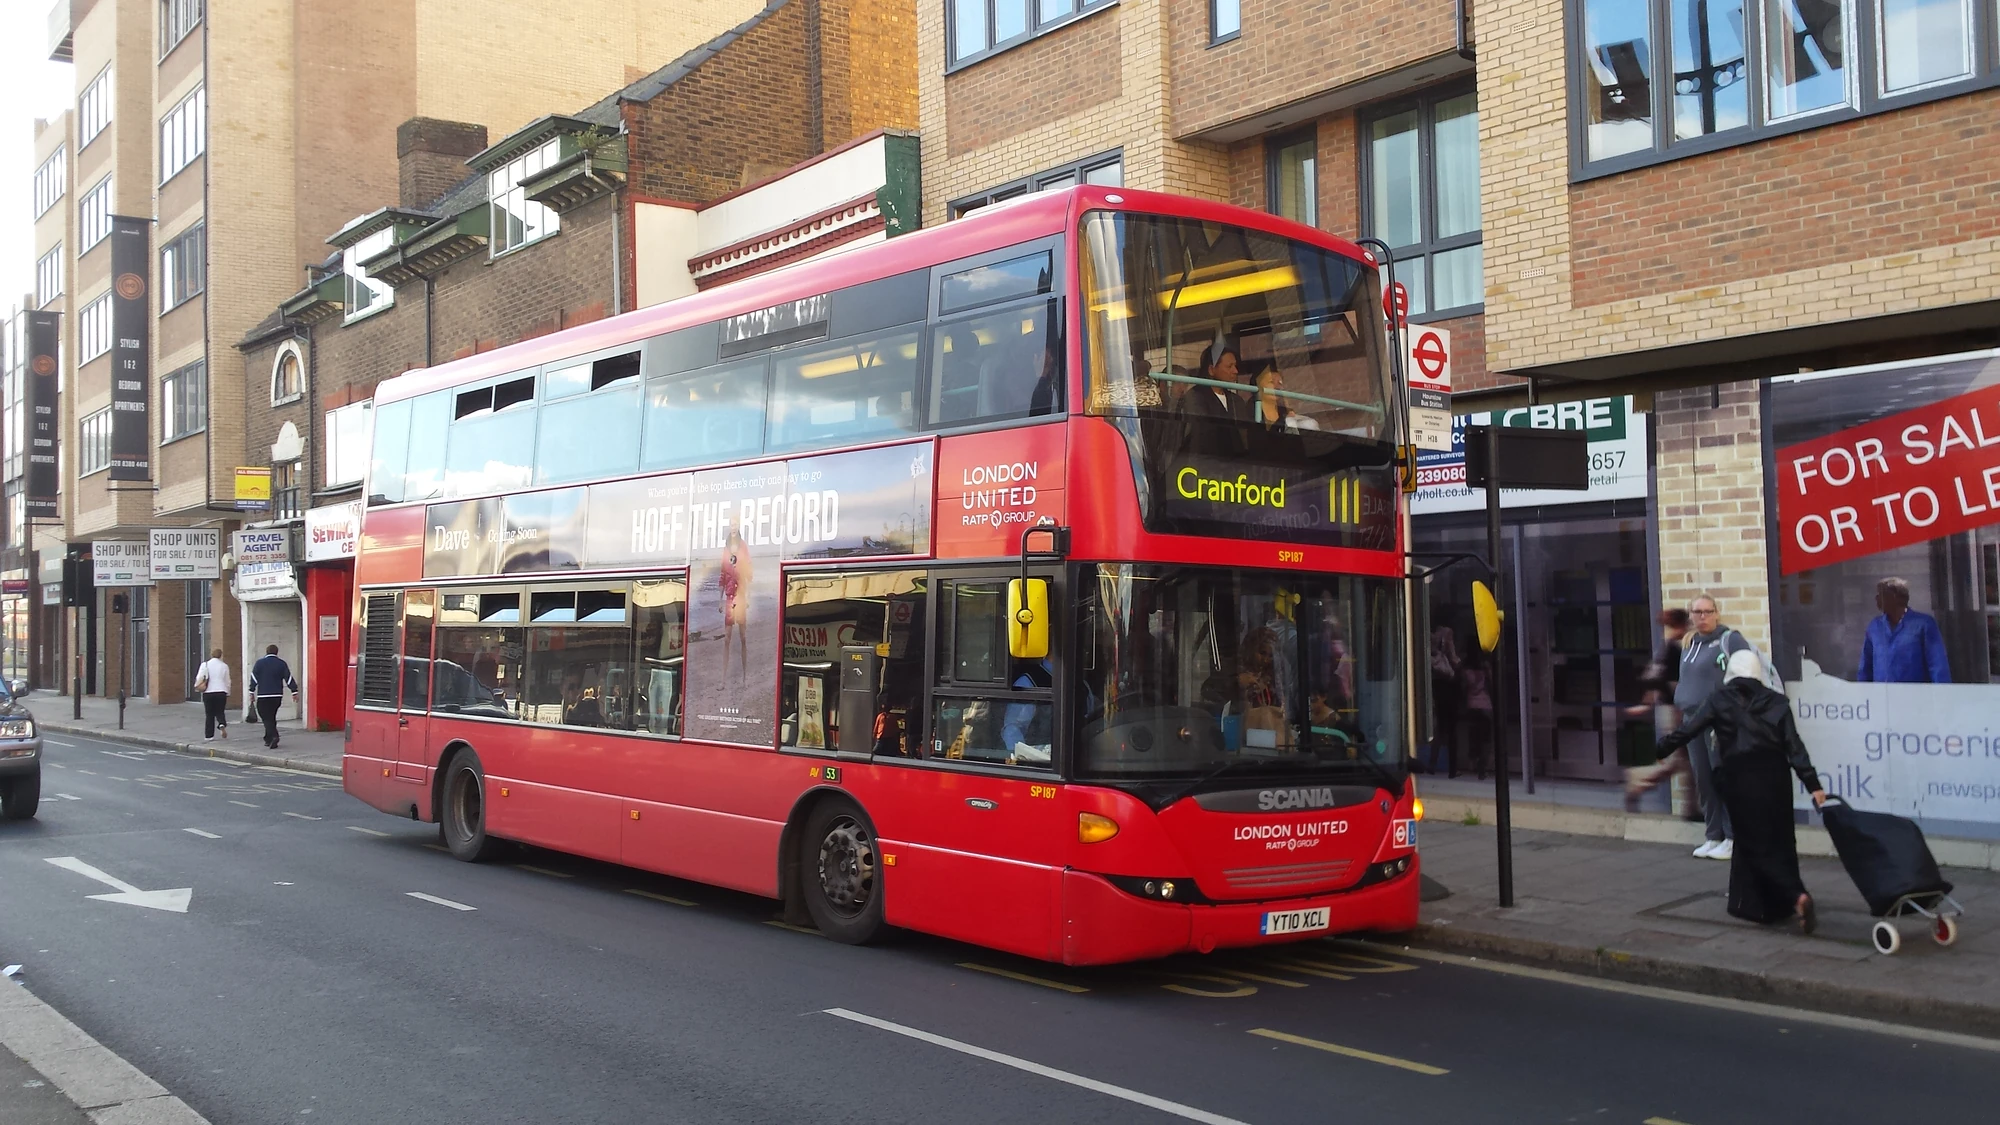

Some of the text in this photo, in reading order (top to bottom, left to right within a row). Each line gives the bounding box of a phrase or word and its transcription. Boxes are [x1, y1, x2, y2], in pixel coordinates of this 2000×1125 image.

[120, 338, 140, 349] STYLISH
[118, 380, 141, 391] BEDROOM
[1422, 393, 1442, 401] Hounslow
[35, 405, 51, 414] STYLISH
[114, 401, 145, 412] APARTMENTS
[1429, 400, 1443, 408] Station
[34, 438, 52, 446] BEDROOM
[1793, 406, 2000, 496] FOR SAL
[30, 455, 55, 464] APARTMENTS
[963, 461, 1037, 486] LONDON
[648, 487, 666, 498] When
[697, 482, 709, 493] the
[710, 481, 722, 494] top
[723, 478, 747, 492] there's
[749, 476, 766, 489] only
[767, 476, 781, 485] one
[801, 472, 809, 481] to
[811, 470, 822, 483] go
[962, 486, 1036, 510] UNITED
[1177, 467, 1361, 525] Cranford 111
[631, 489, 840, 554] HOFF THE RECORD
[962, 511, 1036, 526] RATP GROUP
[1795, 506, 1864, 554] OR
[1872, 486, 1941, 534] TO
[240, 533, 285, 543] TRAVEL
[313, 520, 353, 544] SEWING
[433, 525, 470, 552] Dave
[517, 526, 538, 540] Soon
[153, 533, 217, 546] SHOP UNITS
[95, 545, 122, 556] SHOP
[153, 550, 168, 559] FOR
[169, 550, 186, 559] SALE
[194, 550, 204, 559] TO
[205, 549, 217, 558] LET
[244, 543, 282, 552] AGENT
[341, 541, 355, 554] CE
[95, 559, 109, 568] FOR
[109, 559, 125, 568] SALE
[132, 559, 141, 568] TO
[1278, 551, 1304, 563] SP187
[1798, 697, 1870, 721] bread
[809, 768, 836, 780] AV 53
[1030, 785, 1056, 799] SP187
[1258, 787, 1335, 810] SCANIA
[1928, 780, 2000, 804] newsp
[1234, 820, 1348, 841] LONDON UNITED
[1266, 838, 1320, 850] RATP GROUP
[1272, 911, 1325, 931] YT10 XCL
